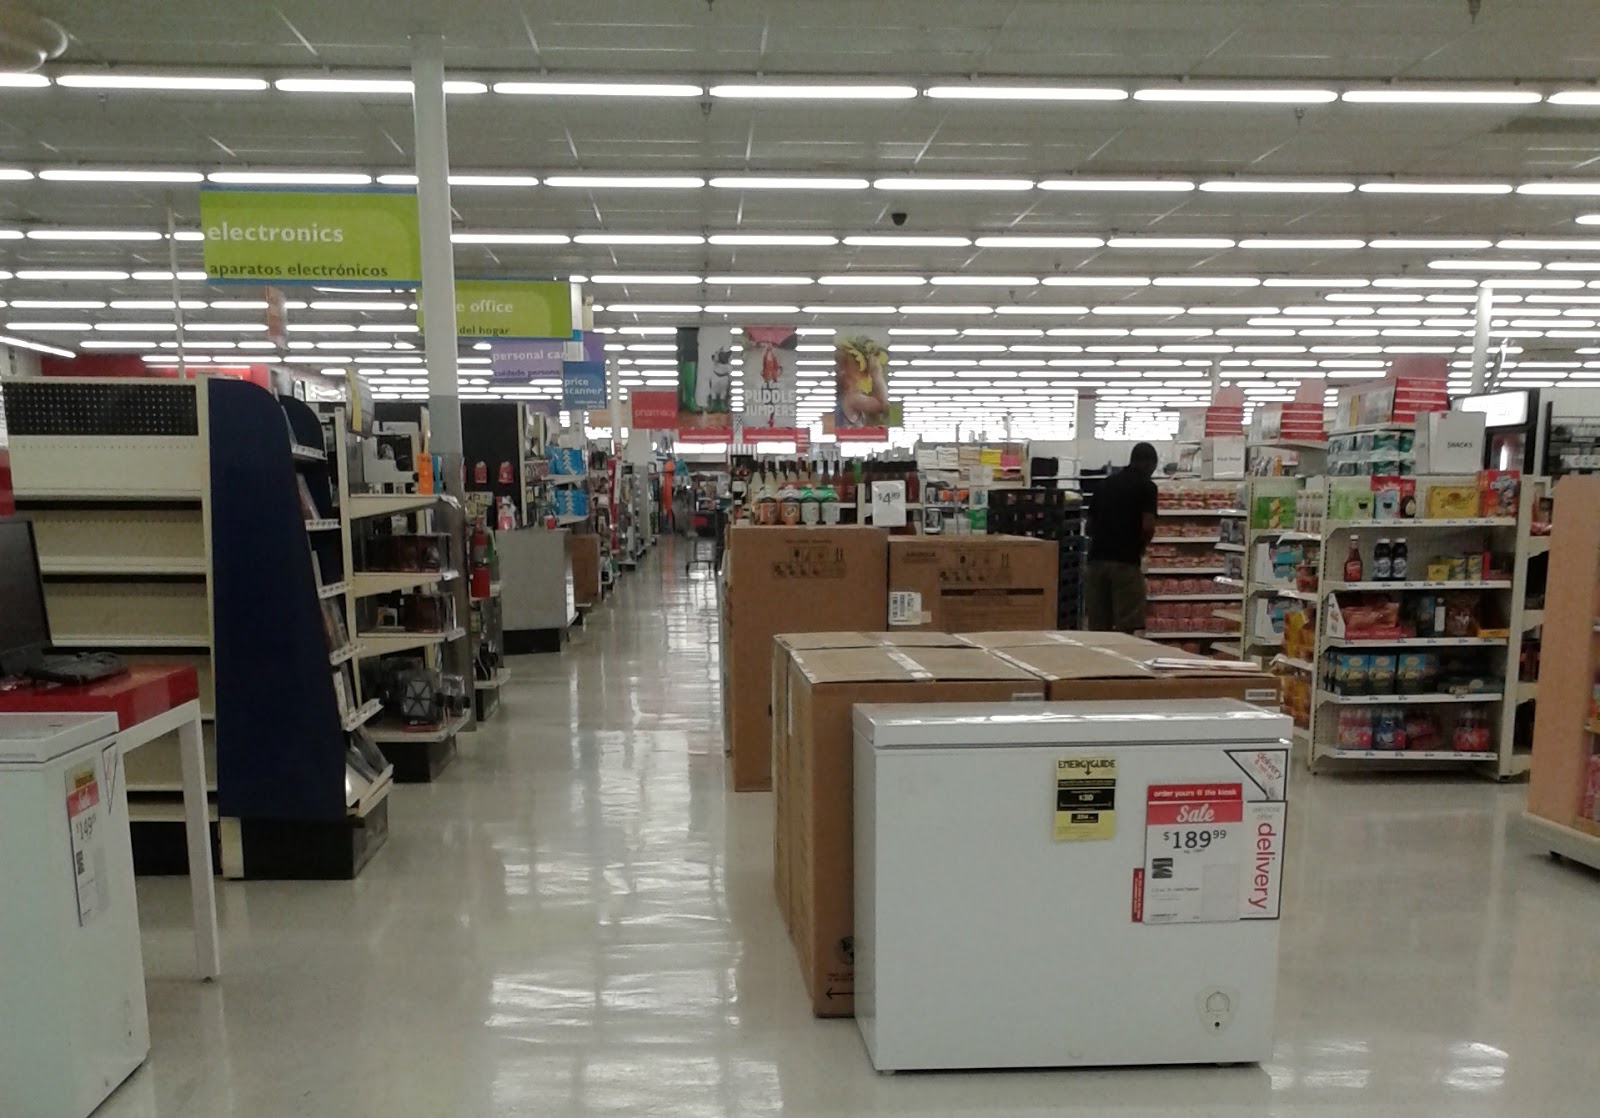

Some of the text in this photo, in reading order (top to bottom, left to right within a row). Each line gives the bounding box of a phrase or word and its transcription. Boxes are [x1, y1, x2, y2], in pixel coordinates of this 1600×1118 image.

[207, 222, 344, 243] electronics
[210, 263, 388, 277] aparatos electrónicos
[470, 299, 513, 313] office
[459, 325, 510, 337] del hogar
[493, 349, 543, 363] personal
[527, 370, 561, 378] persona
[565, 377, 589, 387] price
[565, 387, 602, 395] scanner
[744, 389, 796, 403] PUDDLE
[634, 408, 677, 418] pharmacy
[744, 404, 796, 417] JUMPERS
[1175, 790, 1195, 798] yours
[1218, 788, 1237, 796] kiosk
[1176, 803, 1215, 823] Sale
[1248, 822, 1277, 910] delivery
